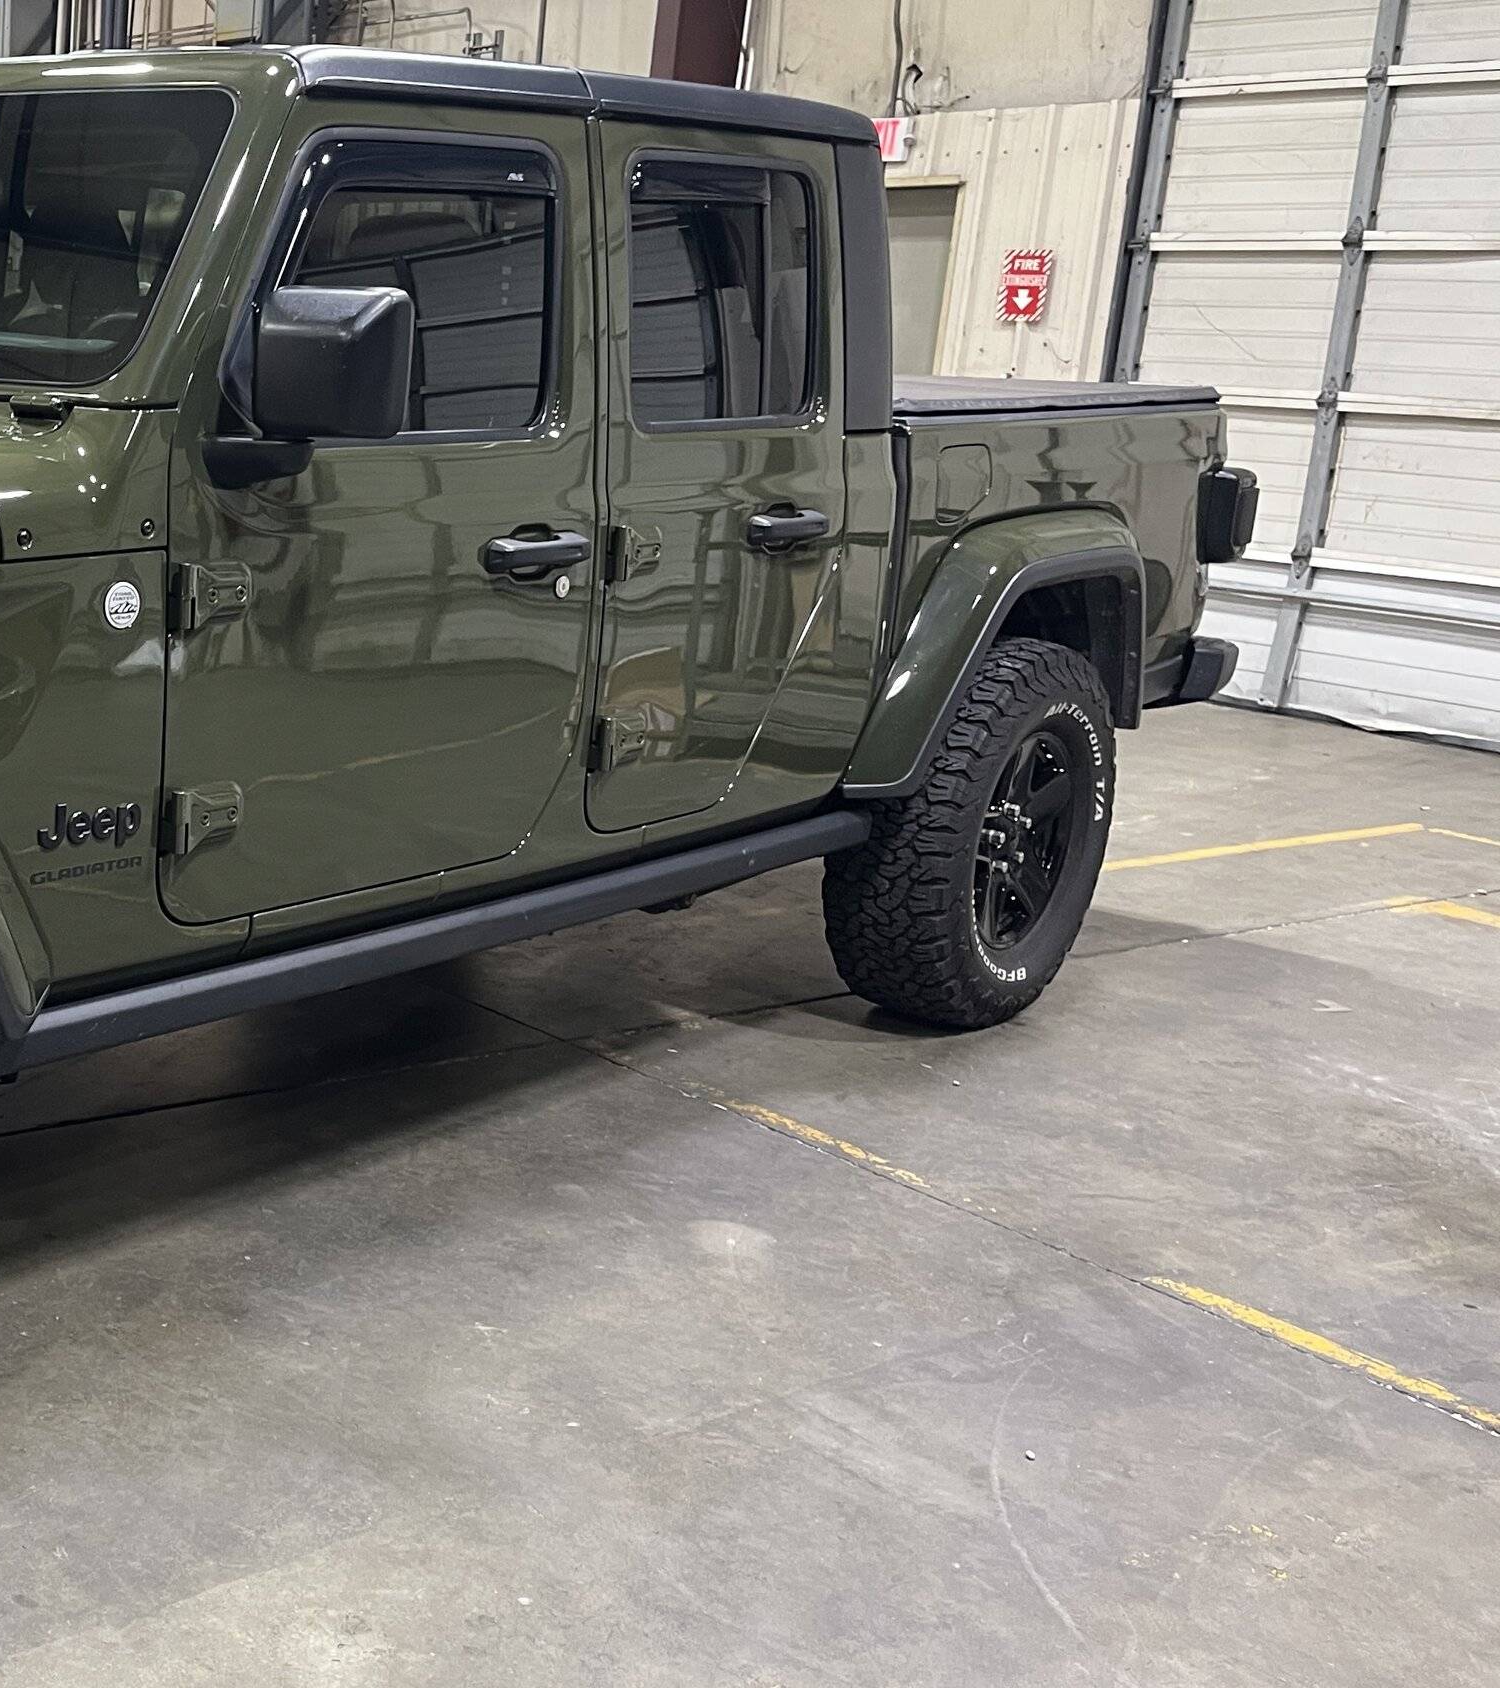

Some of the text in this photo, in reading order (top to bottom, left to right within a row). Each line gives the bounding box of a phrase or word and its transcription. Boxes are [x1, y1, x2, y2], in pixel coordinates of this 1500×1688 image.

[1013, 258, 1041, 271] FIRE
[1044, 702, 1105, 822] All-Terrain T/A
[37, 803, 142, 850] Jeep
[30, 856, 142, 885] GLADIATOR
